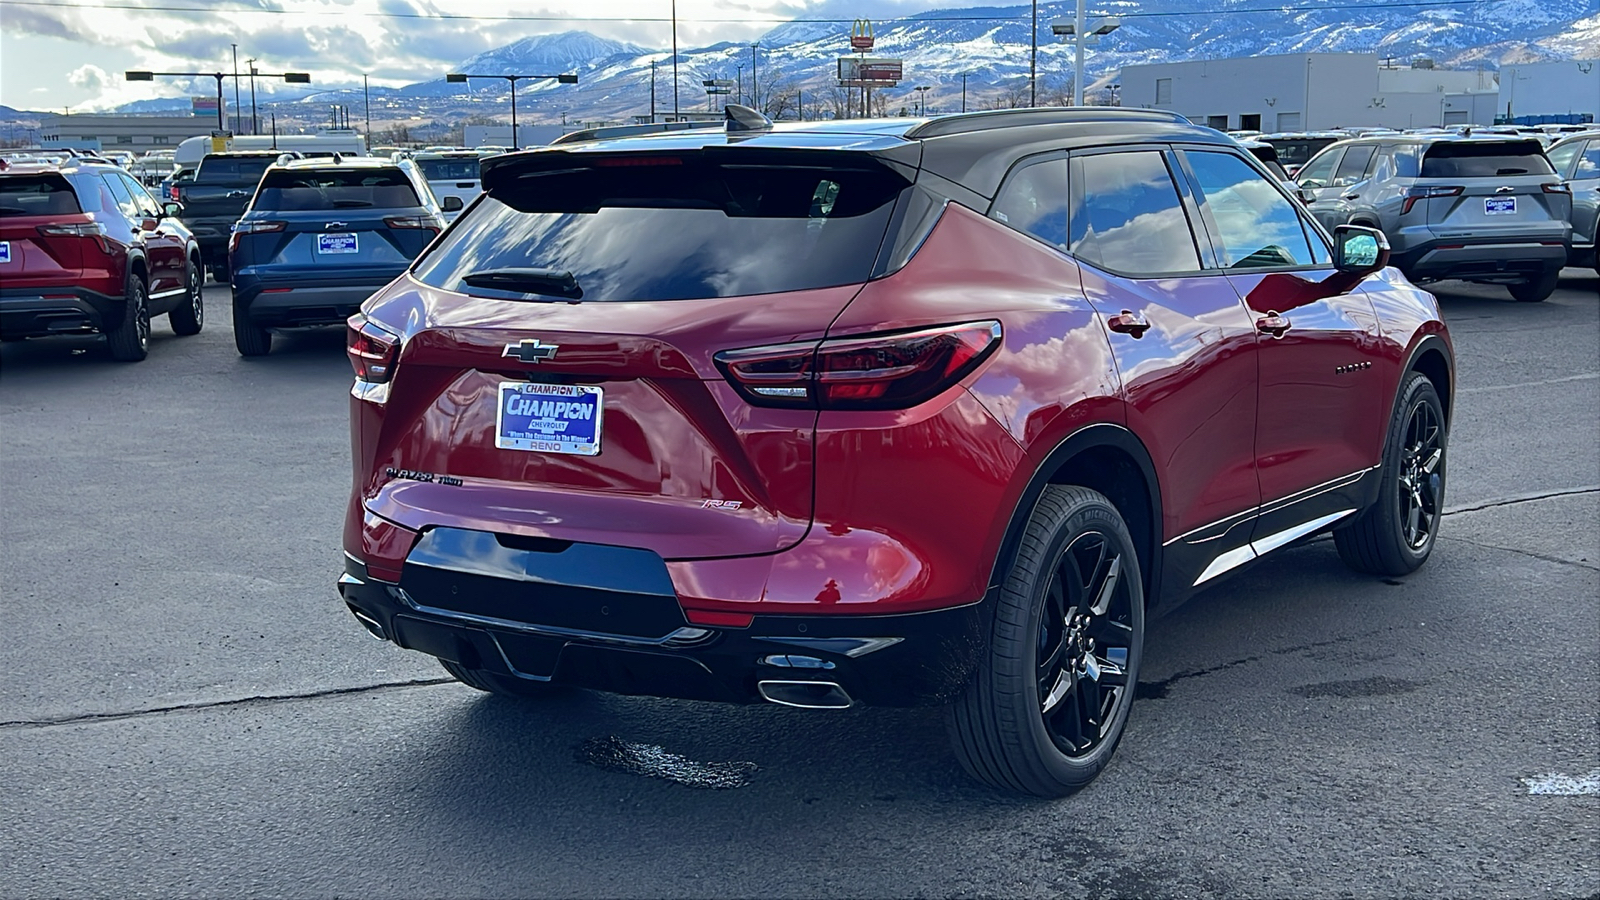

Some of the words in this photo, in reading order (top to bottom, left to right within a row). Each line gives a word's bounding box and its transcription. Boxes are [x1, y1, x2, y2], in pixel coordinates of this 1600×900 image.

[321, 237, 354, 245] CHAMPION
[526, 384, 574, 395] CHAMPION
[506, 394, 593, 420] CHAMPION
[531, 421, 566, 430] CHEVROLET
[530, 441, 561, 451] RENO
[701, 499, 743, 511] RS
[1084, 509, 1120, 528] MICHELIN
